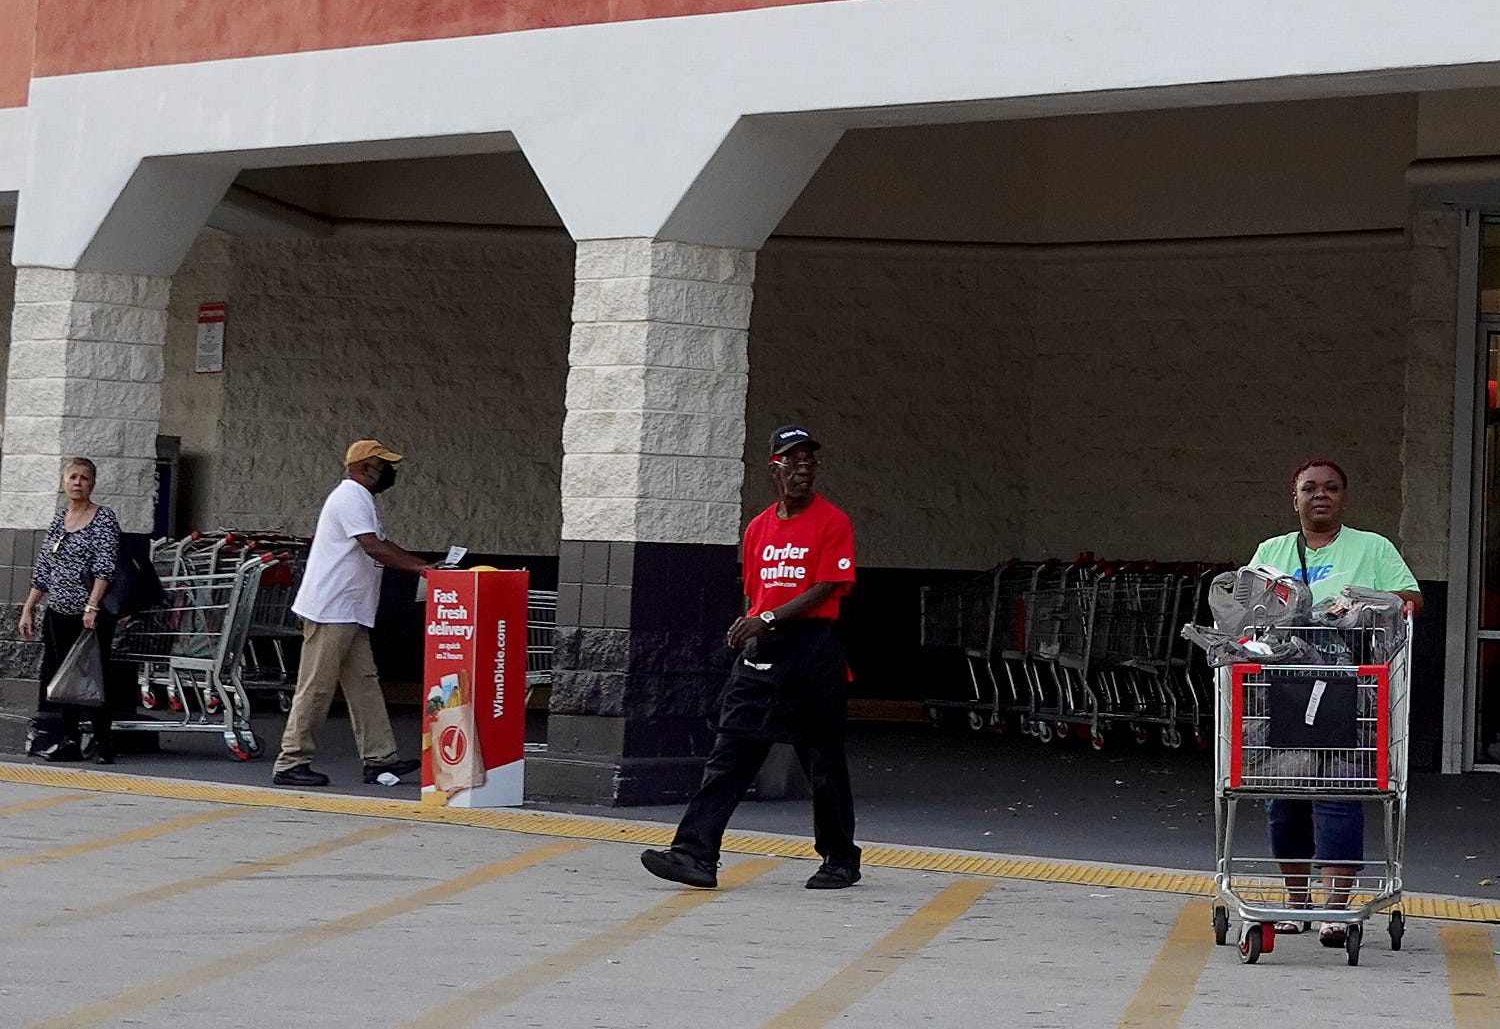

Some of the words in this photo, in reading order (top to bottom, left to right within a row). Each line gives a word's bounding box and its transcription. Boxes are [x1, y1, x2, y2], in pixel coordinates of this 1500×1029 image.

[762, 543, 809, 562] Order
[760, 561, 806, 580] online
[1293, 564, 1333, 584] NKE
[433, 588, 458, 604] Fast
[437, 605, 468, 620] fresh
[427, 621, 474, 640] delivery
[493, 619, 507, 719] WinnDixie.com
